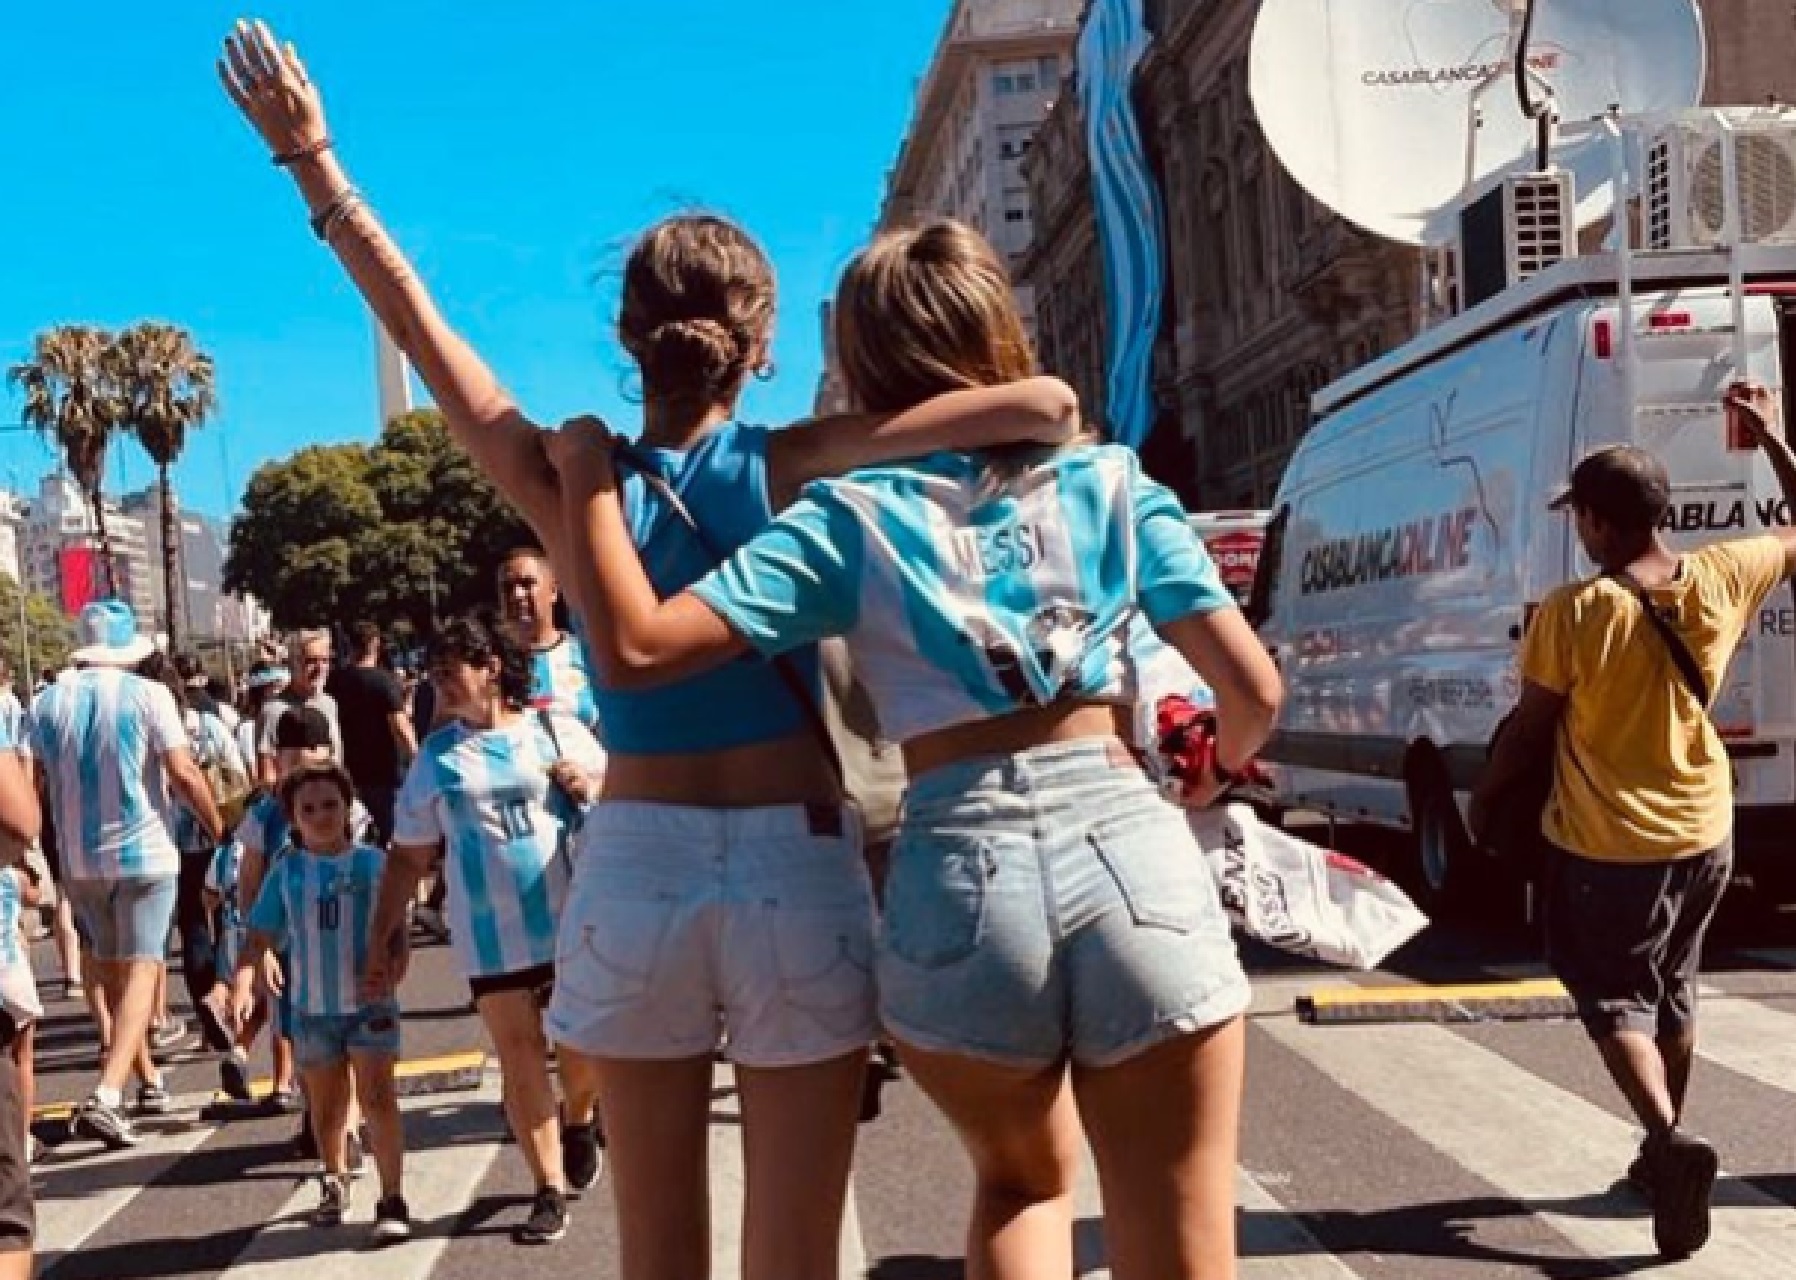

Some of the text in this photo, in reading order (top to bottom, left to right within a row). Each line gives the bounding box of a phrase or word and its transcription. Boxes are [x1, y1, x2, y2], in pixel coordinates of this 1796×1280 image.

[951, 523, 1046, 577] MESSI
[492, 797, 534, 840] 10
[316, 894, 339, 931] 10
